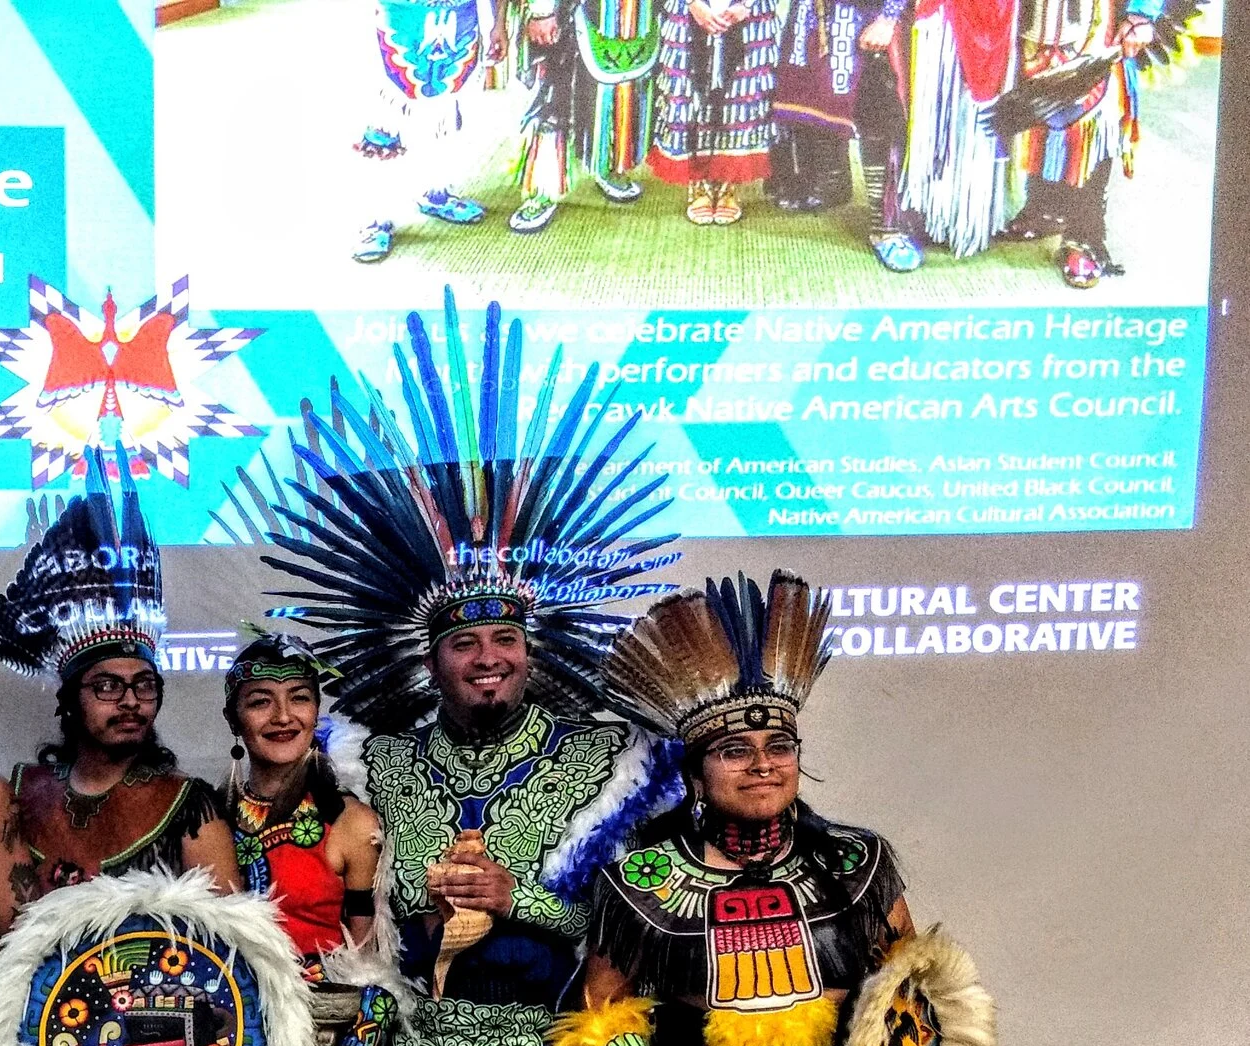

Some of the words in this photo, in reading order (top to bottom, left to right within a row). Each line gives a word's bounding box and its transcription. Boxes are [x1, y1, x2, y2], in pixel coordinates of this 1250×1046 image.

[525, 322, 579, 343] we
[586, 316, 744, 343] celebrate
[754, 314, 863, 342] Native
[871, 314, 1035, 342] American
[1045, 312, 1188, 346] Heritage
[600, 357, 783, 391] performers
[792, 355, 858, 382] and
[867, 353, 1031, 381] educators
[1042, 352, 1120, 379] from
[1130, 351, 1186, 377] the
[684, 396, 794, 422] Native
[801, 394, 964, 421] American
[970, 392, 1039, 419] Arts
[1049, 390, 1181, 418] Council.
[697, 457, 721, 475] of
[725, 456, 834, 475] American
[928, 454, 991, 473] Asian
[997, 453, 1083, 471] Student
[943, 479, 1018, 498] United
[1024, 477, 1081, 497] Black
[768, 507, 840, 526] Native
[843, 505, 951, 525] American
[956, 503, 1045, 523] Cultural
[1049, 501, 1175, 521] Association
[989, 582, 1139, 614] CENTER
[823, 620, 1137, 657] COLLABORATIVE
